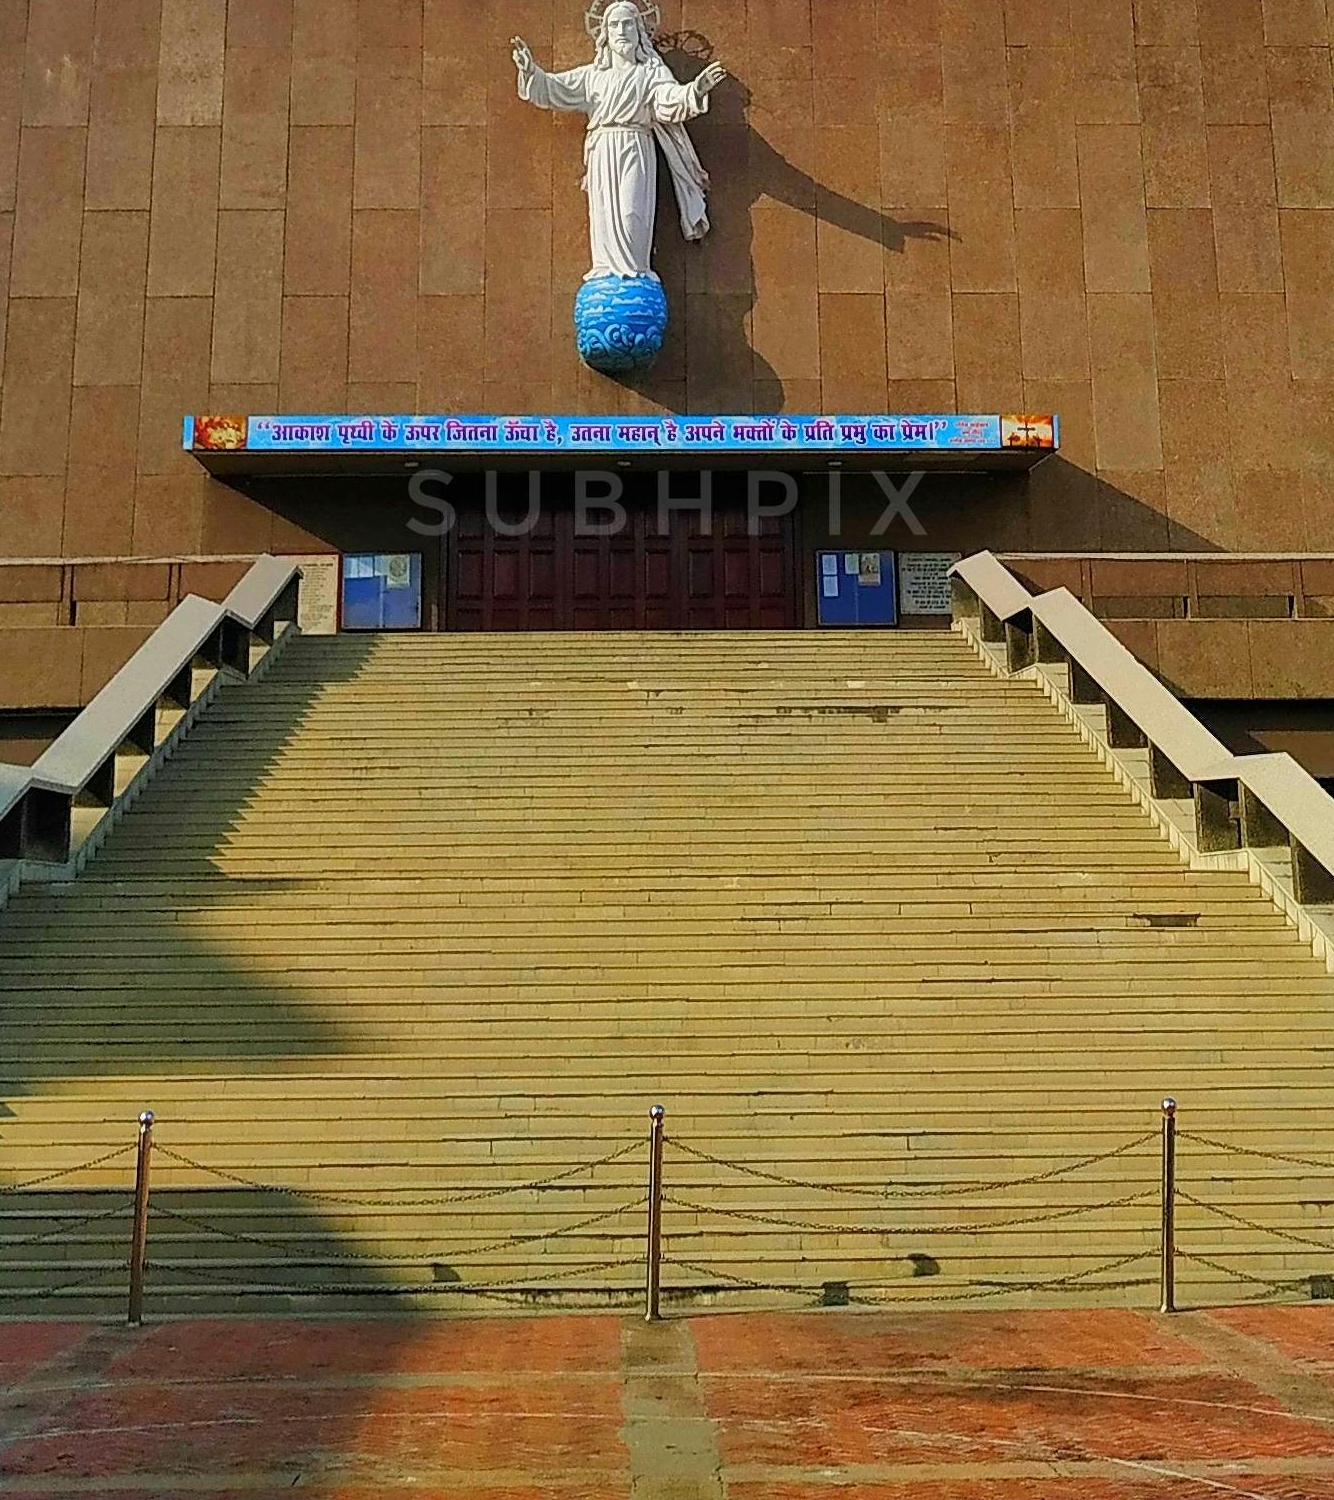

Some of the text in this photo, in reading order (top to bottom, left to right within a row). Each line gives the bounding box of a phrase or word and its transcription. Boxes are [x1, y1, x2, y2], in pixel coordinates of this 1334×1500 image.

[381, 420, 399, 441] के
[405, 424, 440, 441] ऊपर
[446, 420, 498, 441] जितना
[570, 425, 611, 441] उतना
[617, 425, 661, 446] महान्
[664, 420, 677, 441] है
[685, 420, 726, 441] अपने
[779, 420, 797, 441] के
[804, 420, 834, 441] प्रति
[840, 424, 867, 444] प्रभु
[872, 424, 896, 441] का
